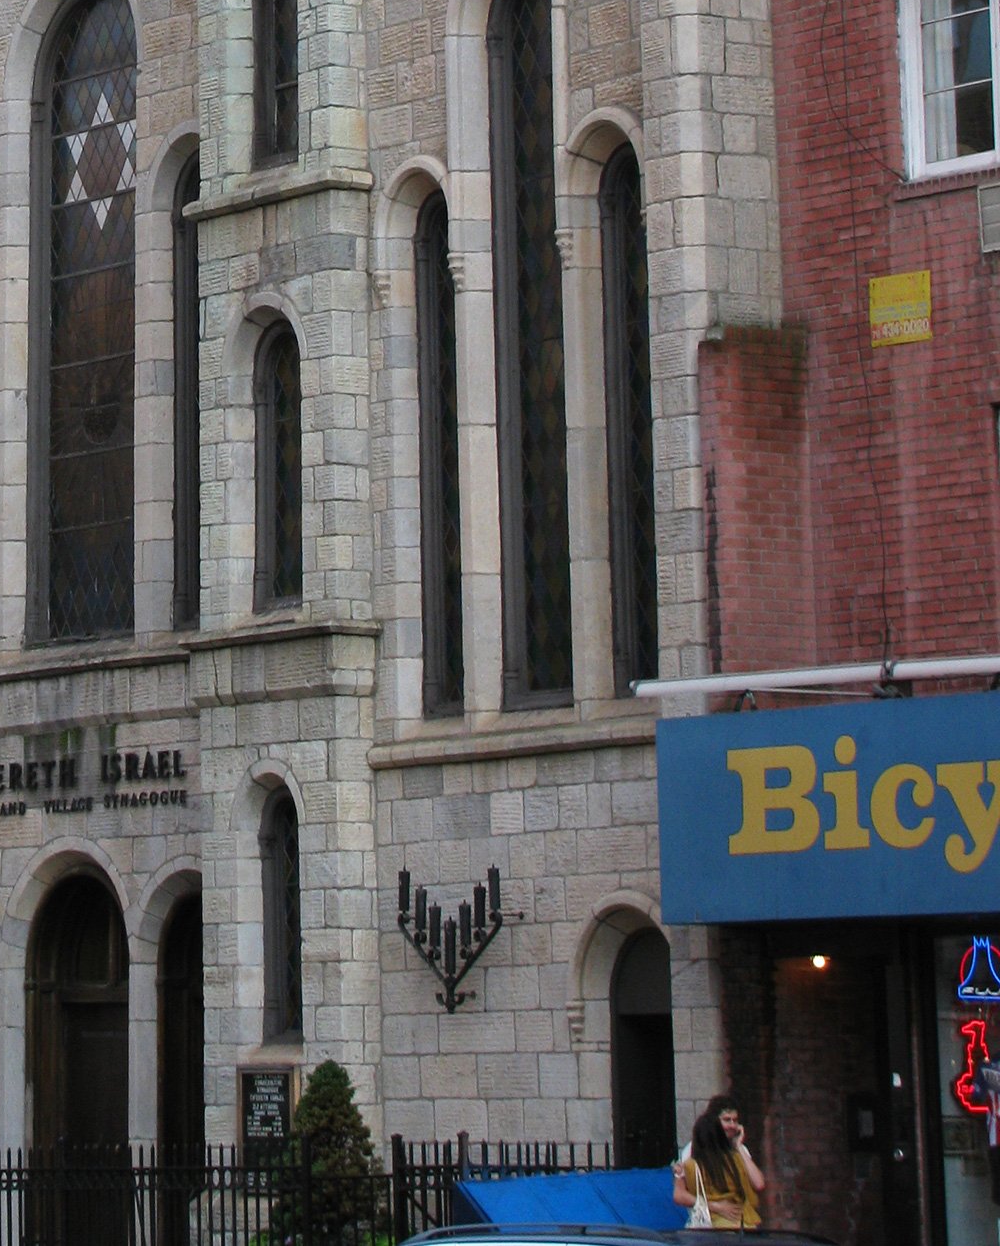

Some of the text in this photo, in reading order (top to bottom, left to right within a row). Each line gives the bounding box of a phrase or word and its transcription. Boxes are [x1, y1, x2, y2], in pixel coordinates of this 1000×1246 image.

[101, 750, 188, 784] ISRAEL
[0, 801, 26, 817] AND
[44, 797, 94, 814] VILLAGE
[104, 790, 188, 809] SYNAGOGUE
[727, 735, 1000, 874] Bicy
